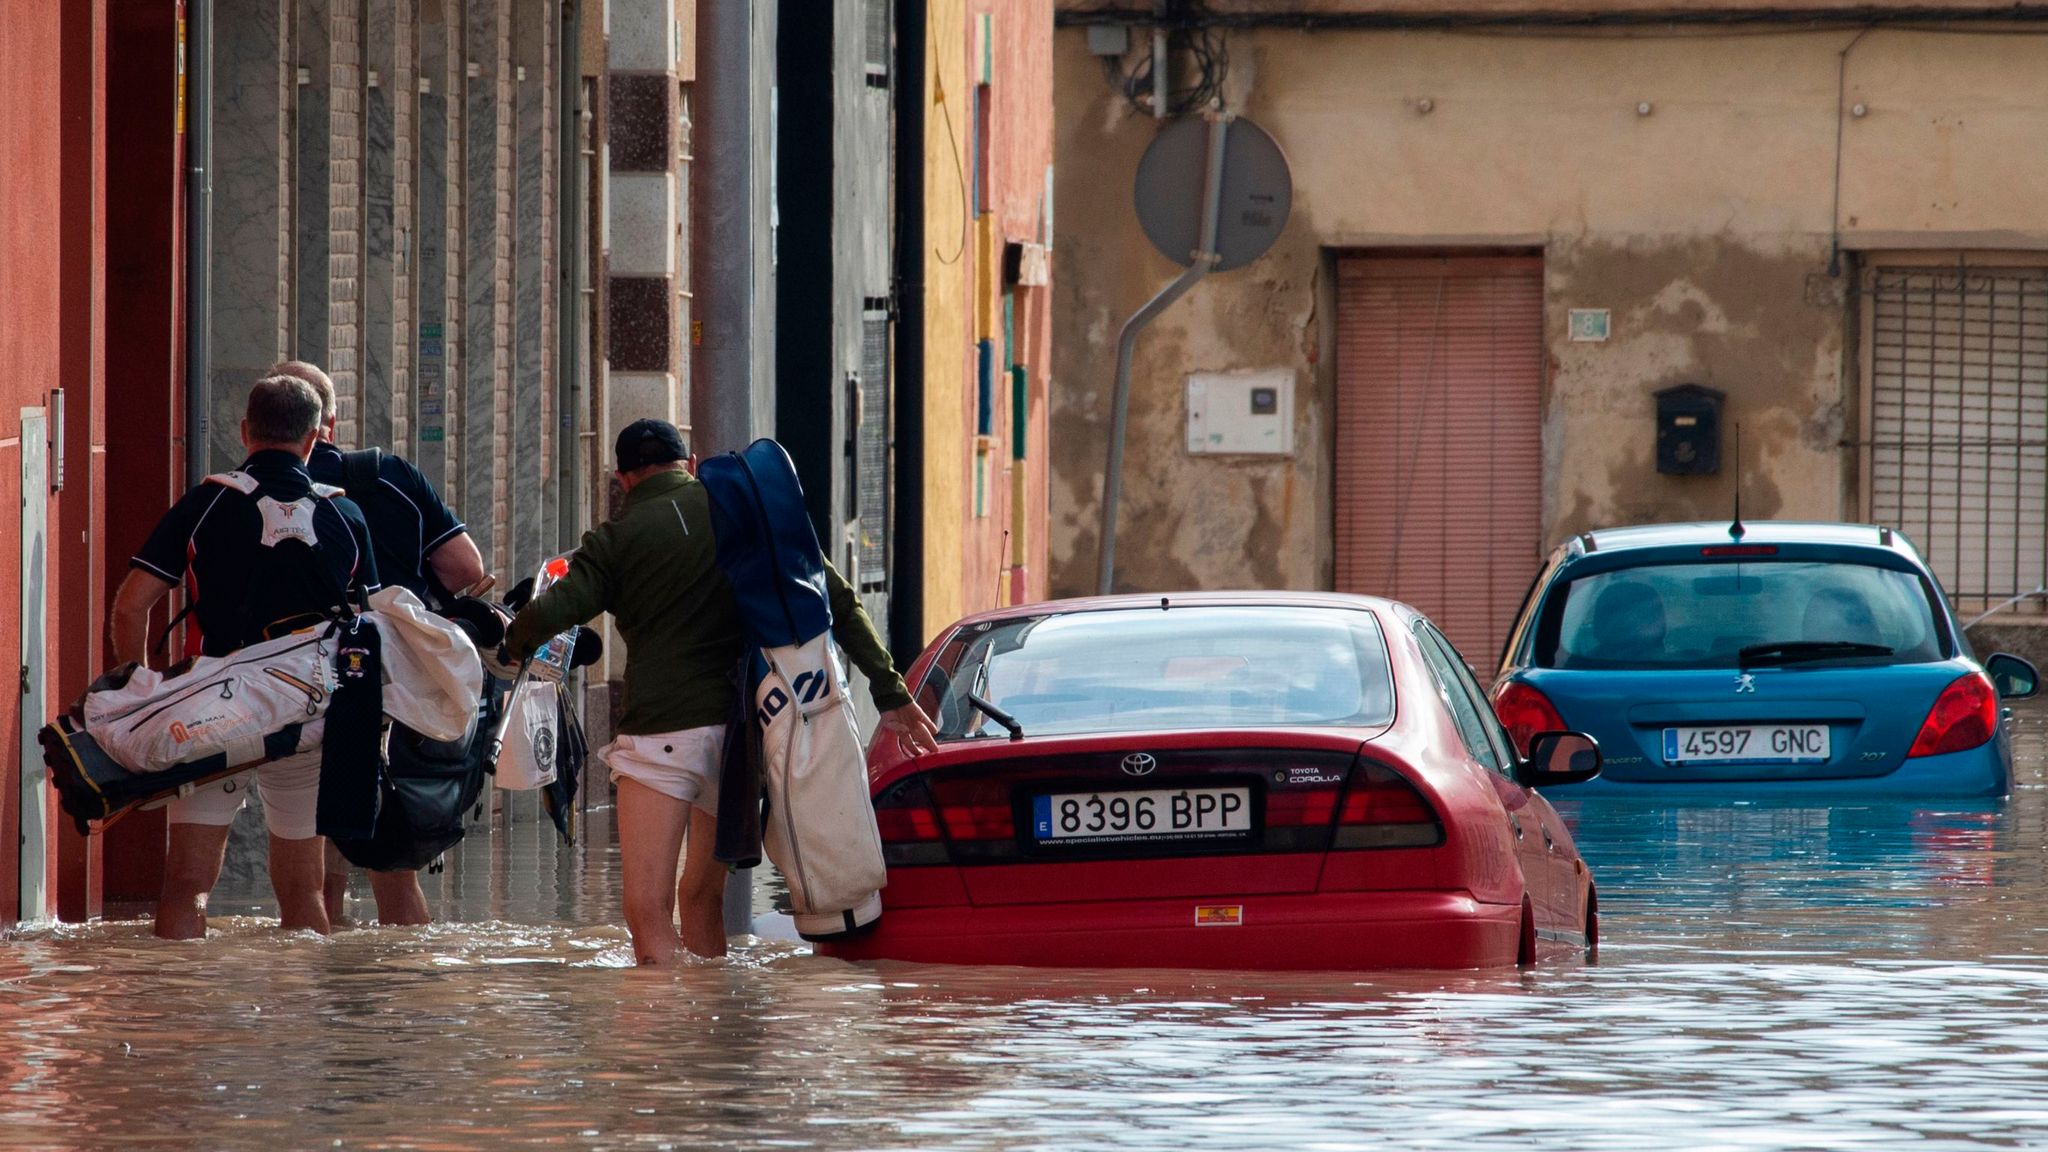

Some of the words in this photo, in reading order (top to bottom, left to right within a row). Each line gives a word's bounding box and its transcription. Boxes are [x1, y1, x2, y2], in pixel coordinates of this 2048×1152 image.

[1685, 730, 1751, 756] 4597
[1771, 729, 1821, 754] GNC
[1858, 751, 1887, 761] 207
[1290, 767, 1320, 775] TOYOTA
[1289, 774, 1342, 783] COROLLA
[1039, 821, 1048, 832] E
[1060, 796, 1156, 833] 8396
[1171, 792, 1242, 830] BPP
[1039, 834, 1162, 845] www.specialistvehicles.eu
